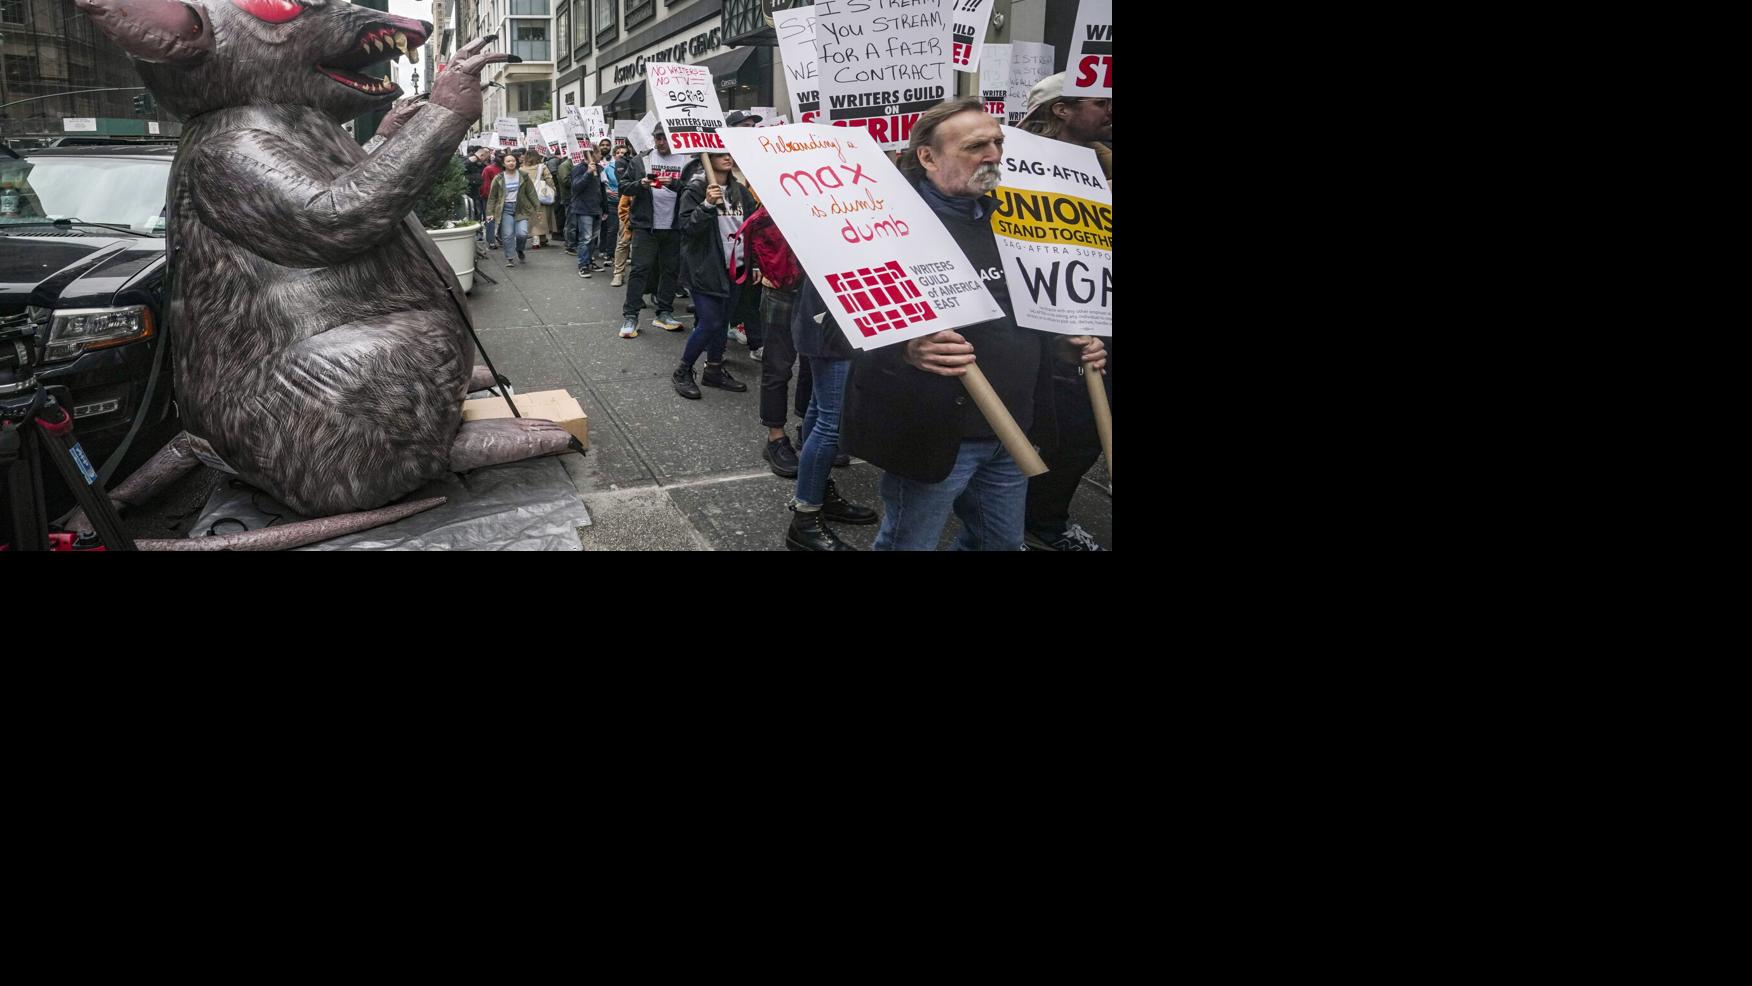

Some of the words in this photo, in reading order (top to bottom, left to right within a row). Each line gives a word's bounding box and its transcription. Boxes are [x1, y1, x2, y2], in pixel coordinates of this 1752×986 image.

[822, 23, 863, 44] YOU
[872, 11, 946, 32] STREAM,
[673, 41, 687, 62] OF
[689, 27, 720, 56] GEMS
[819, 42, 860, 64] FOR
[865, 43, 880, 59] A
[651, 66, 666, 76] NO
[834, 62, 946, 83] CONTRACT
[657, 77, 670, 86] NO
[829, 90, 899, 108] WRITERS
[903, 85, 945, 101] GUILD
[885, 105, 899, 114] ON
[665, 118, 701, 127] WRITERS
[758, 134, 846, 163] Rebranding
[810, 203, 827, 218] is
[830, 188, 884, 215] dumb
[841, 214, 909, 244] dumb
[998, 220, 1047, 239] STAND
[1075, 248, 1112, 261] SUPPO
[909, 260, 955, 276] WRITERS
[918, 273, 949, 287] GUILD
[928, 287, 940, 299] of
[939, 280, 983, 297] AMERICA
